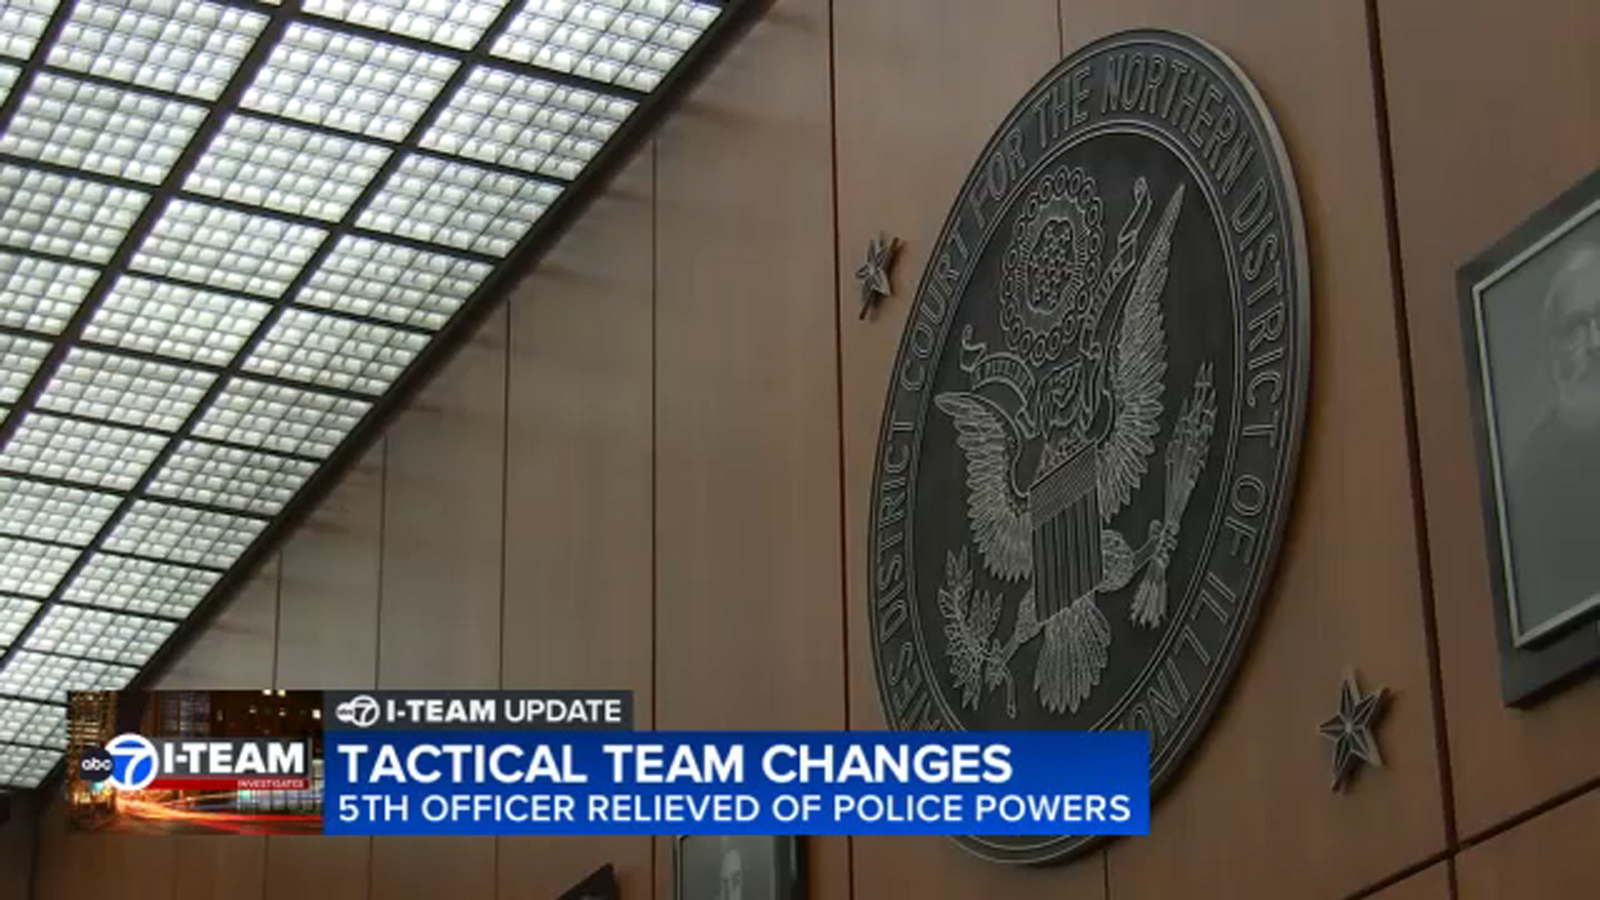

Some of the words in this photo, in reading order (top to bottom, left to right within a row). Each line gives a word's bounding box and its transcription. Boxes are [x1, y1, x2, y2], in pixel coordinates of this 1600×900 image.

[1033, 66, 1094, 148] THE
[1100, 52, 1255, 195] NORTHERN
[971, 128, 1028, 230] FOR
[900, 226, 975, 392] COURT
[1232, 179, 1288, 449] DISTRICT
[877, 411, 912, 643] DISTRICT
[1225, 473, 1266, 565] OF
